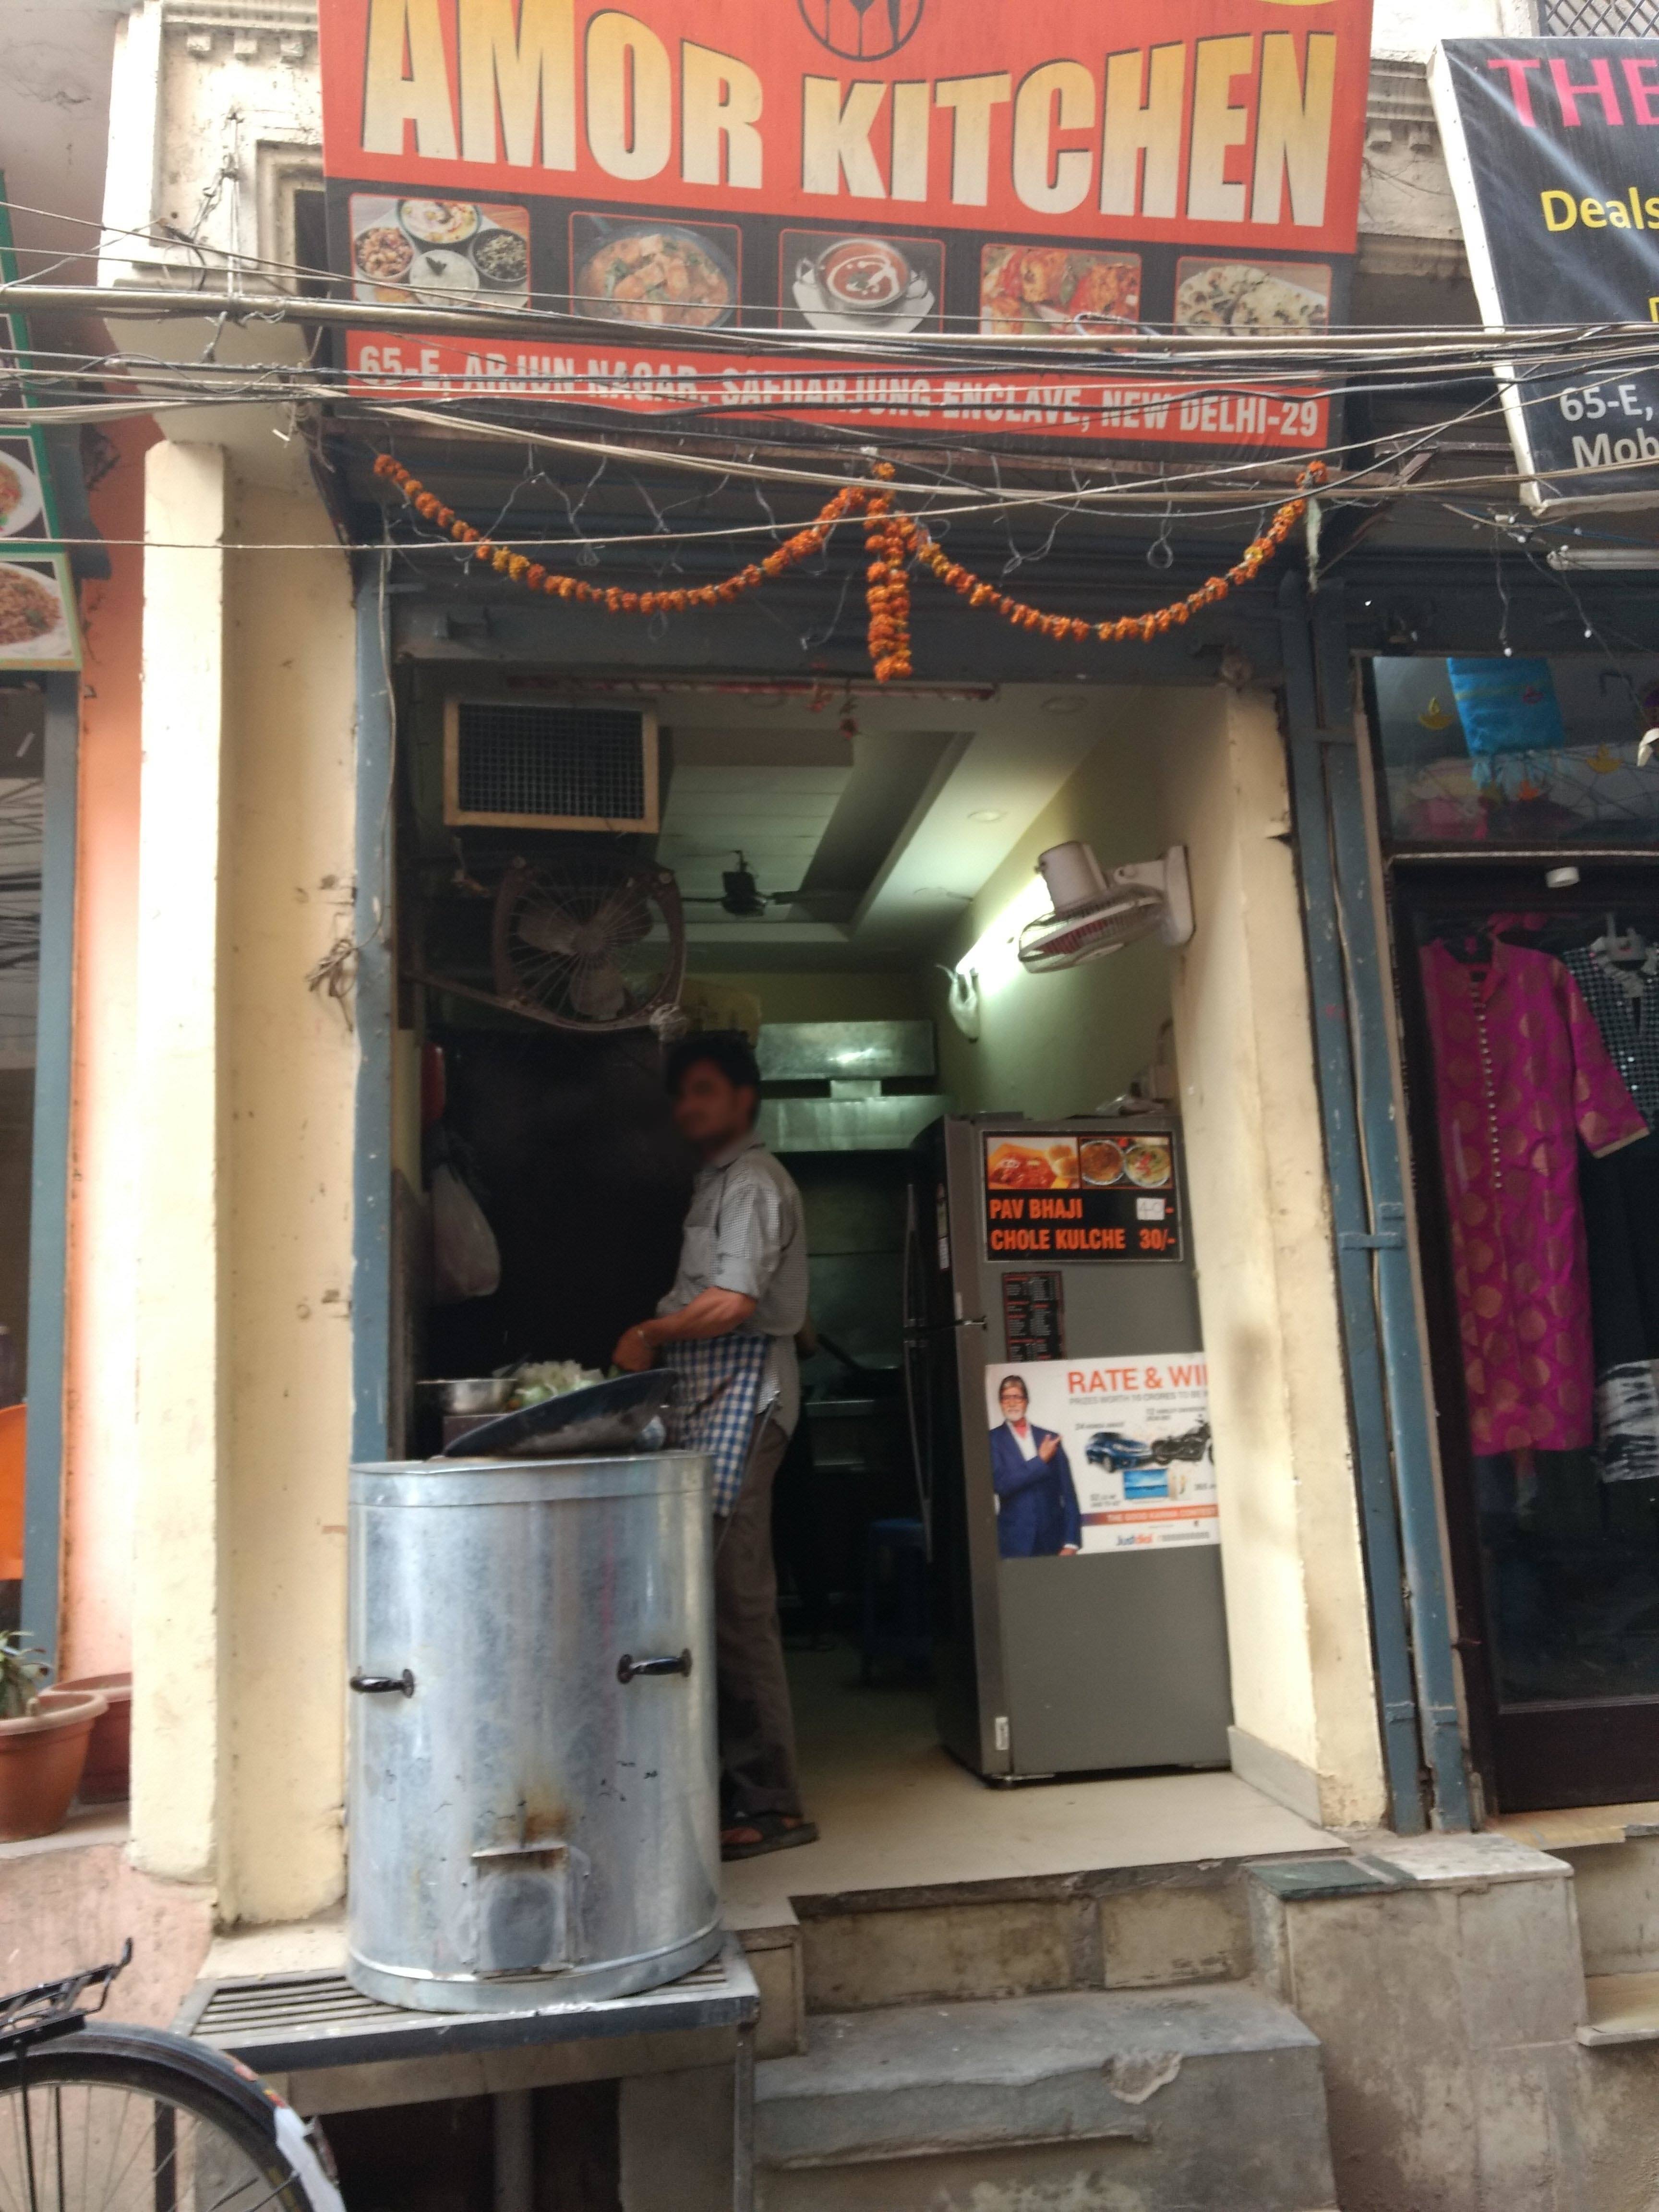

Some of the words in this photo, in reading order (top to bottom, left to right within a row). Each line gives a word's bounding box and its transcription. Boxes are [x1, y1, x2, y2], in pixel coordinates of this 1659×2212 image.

[1489, 58, 1659, 127] THE
[361, 0, 762, 190] AMOR
[802, 31, 1337, 227] KITCHEN
[1541, 186, 1659, 231] Deals
[463, 352, 574, 392] ARJUN
[943, 381, 1090, 432] ENCLAVE,
[1101, 390, 1175, 430] NEW
[1180, 392, 1318, 437] DELHI-29
[1561, 384, 1653, 421] 65-E,
[989, 1198, 1024, 1219] PAV
[1029, 1197, 1083, 1219] BHAJI
[991, 1228, 1050, 1250] CHOLE
[1055, 1228, 1126, 1249] KULCHE
[1068, 1369, 1139, 1394] RATE
[1145, 1367, 1163, 1390] &
